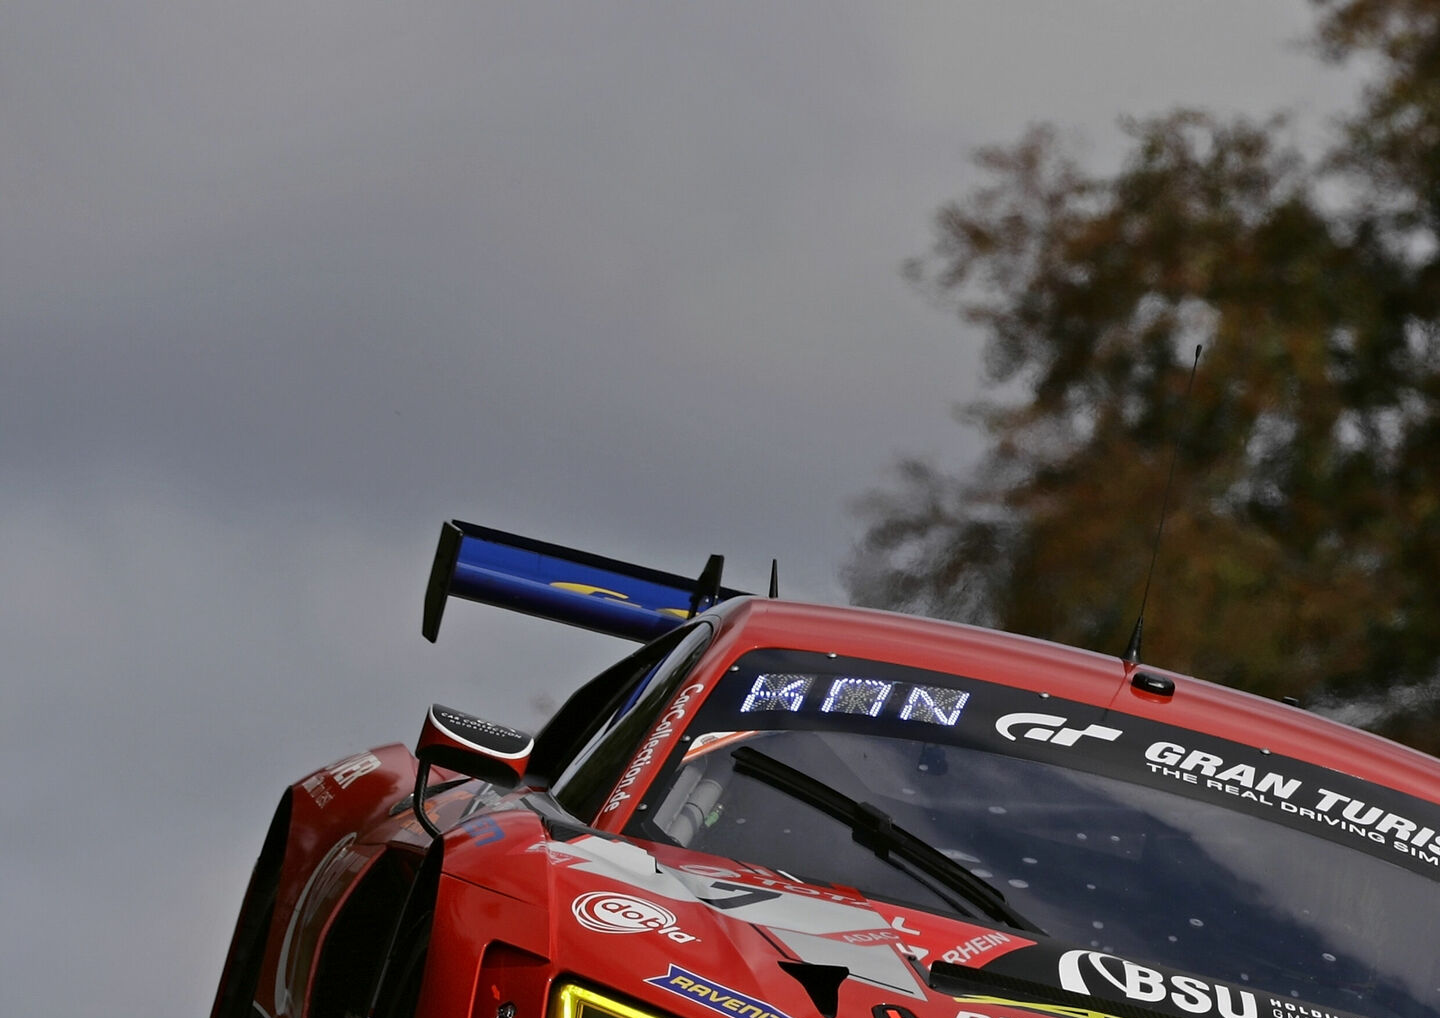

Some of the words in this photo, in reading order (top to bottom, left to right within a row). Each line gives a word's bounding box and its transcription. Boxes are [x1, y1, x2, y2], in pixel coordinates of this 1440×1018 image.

[603, 683, 705, 813] CarCollection.de
[995, 712, 1123, 747] GT
[1144, 741, 1302, 800] GRAN
[1146, 763, 1198, 785] THE
[1207, 780, 1273, 806] REAL
[1280, 802, 1385, 844] DRIVING
[696, 881, 783, 910] 7
[843, 931, 900, 944] ADAC
